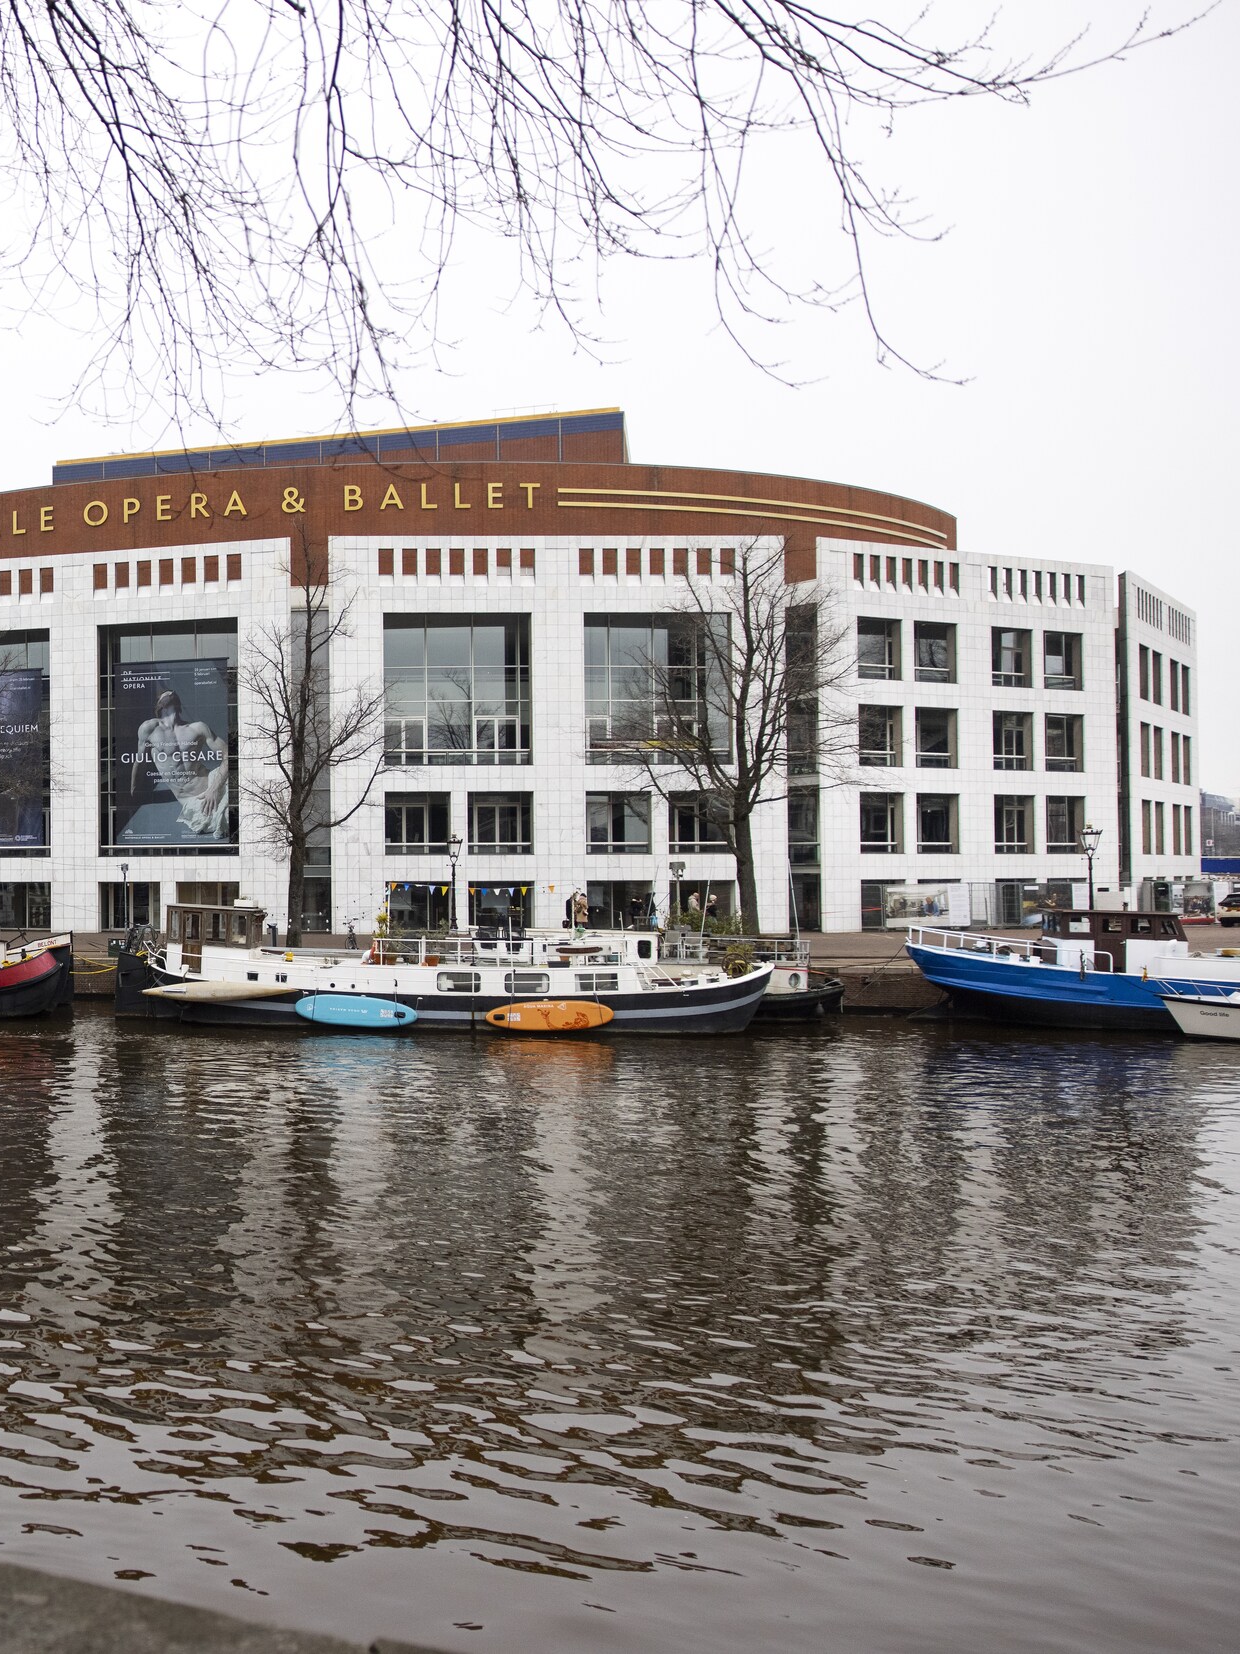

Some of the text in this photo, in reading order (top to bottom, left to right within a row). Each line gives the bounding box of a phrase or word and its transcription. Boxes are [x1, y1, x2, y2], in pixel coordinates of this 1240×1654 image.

[82, 490, 248, 527] OPERA
[281, 486, 306, 514] &
[343, 482, 541, 512] BALLET
[120, 750, 223, 764] GIULIO CESARE
